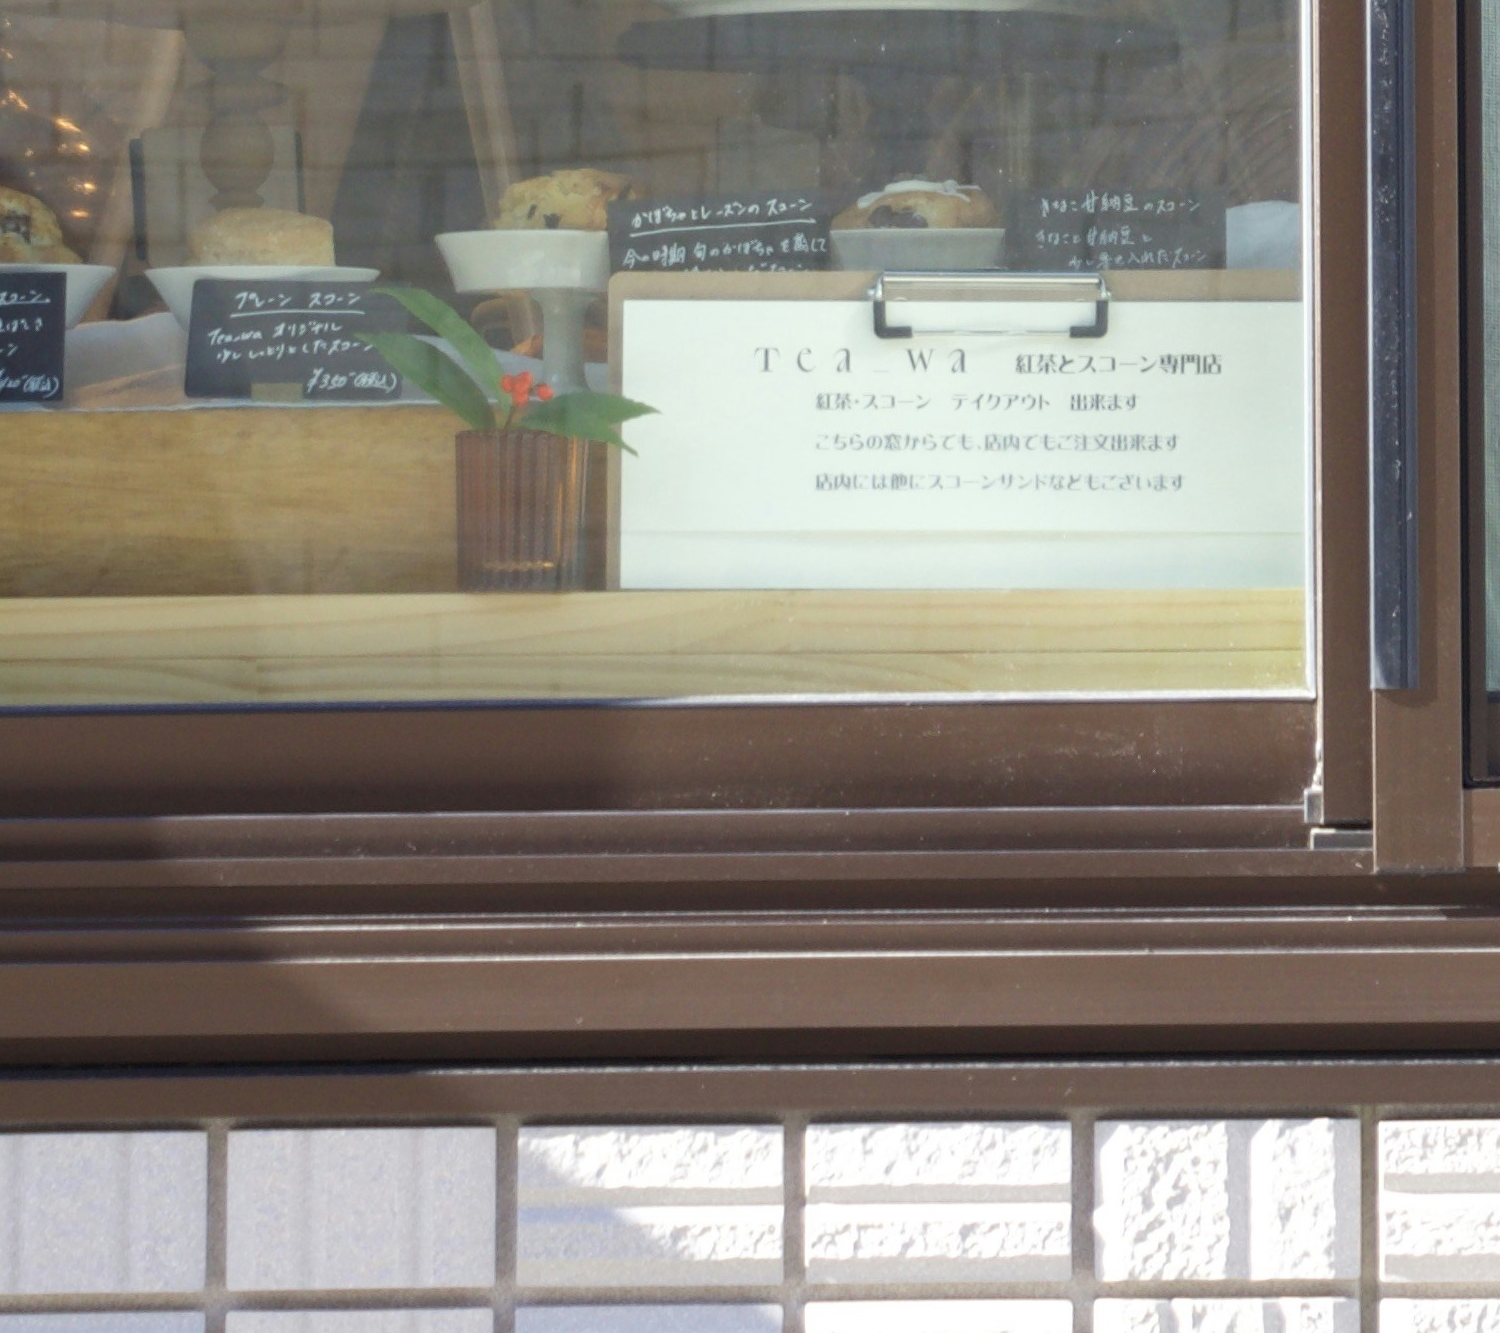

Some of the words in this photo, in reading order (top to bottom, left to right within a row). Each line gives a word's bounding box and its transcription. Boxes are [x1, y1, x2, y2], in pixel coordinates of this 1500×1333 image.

[1015, 353, 1223, 375] 紅茶とスコーン専門店
[951, 393, 1050, 411] テイクアウト
[1070, 393, 1139, 411] 出来ます
[815, 473, 1184, 491] 店内には他にスコーンサンドなどもございます
